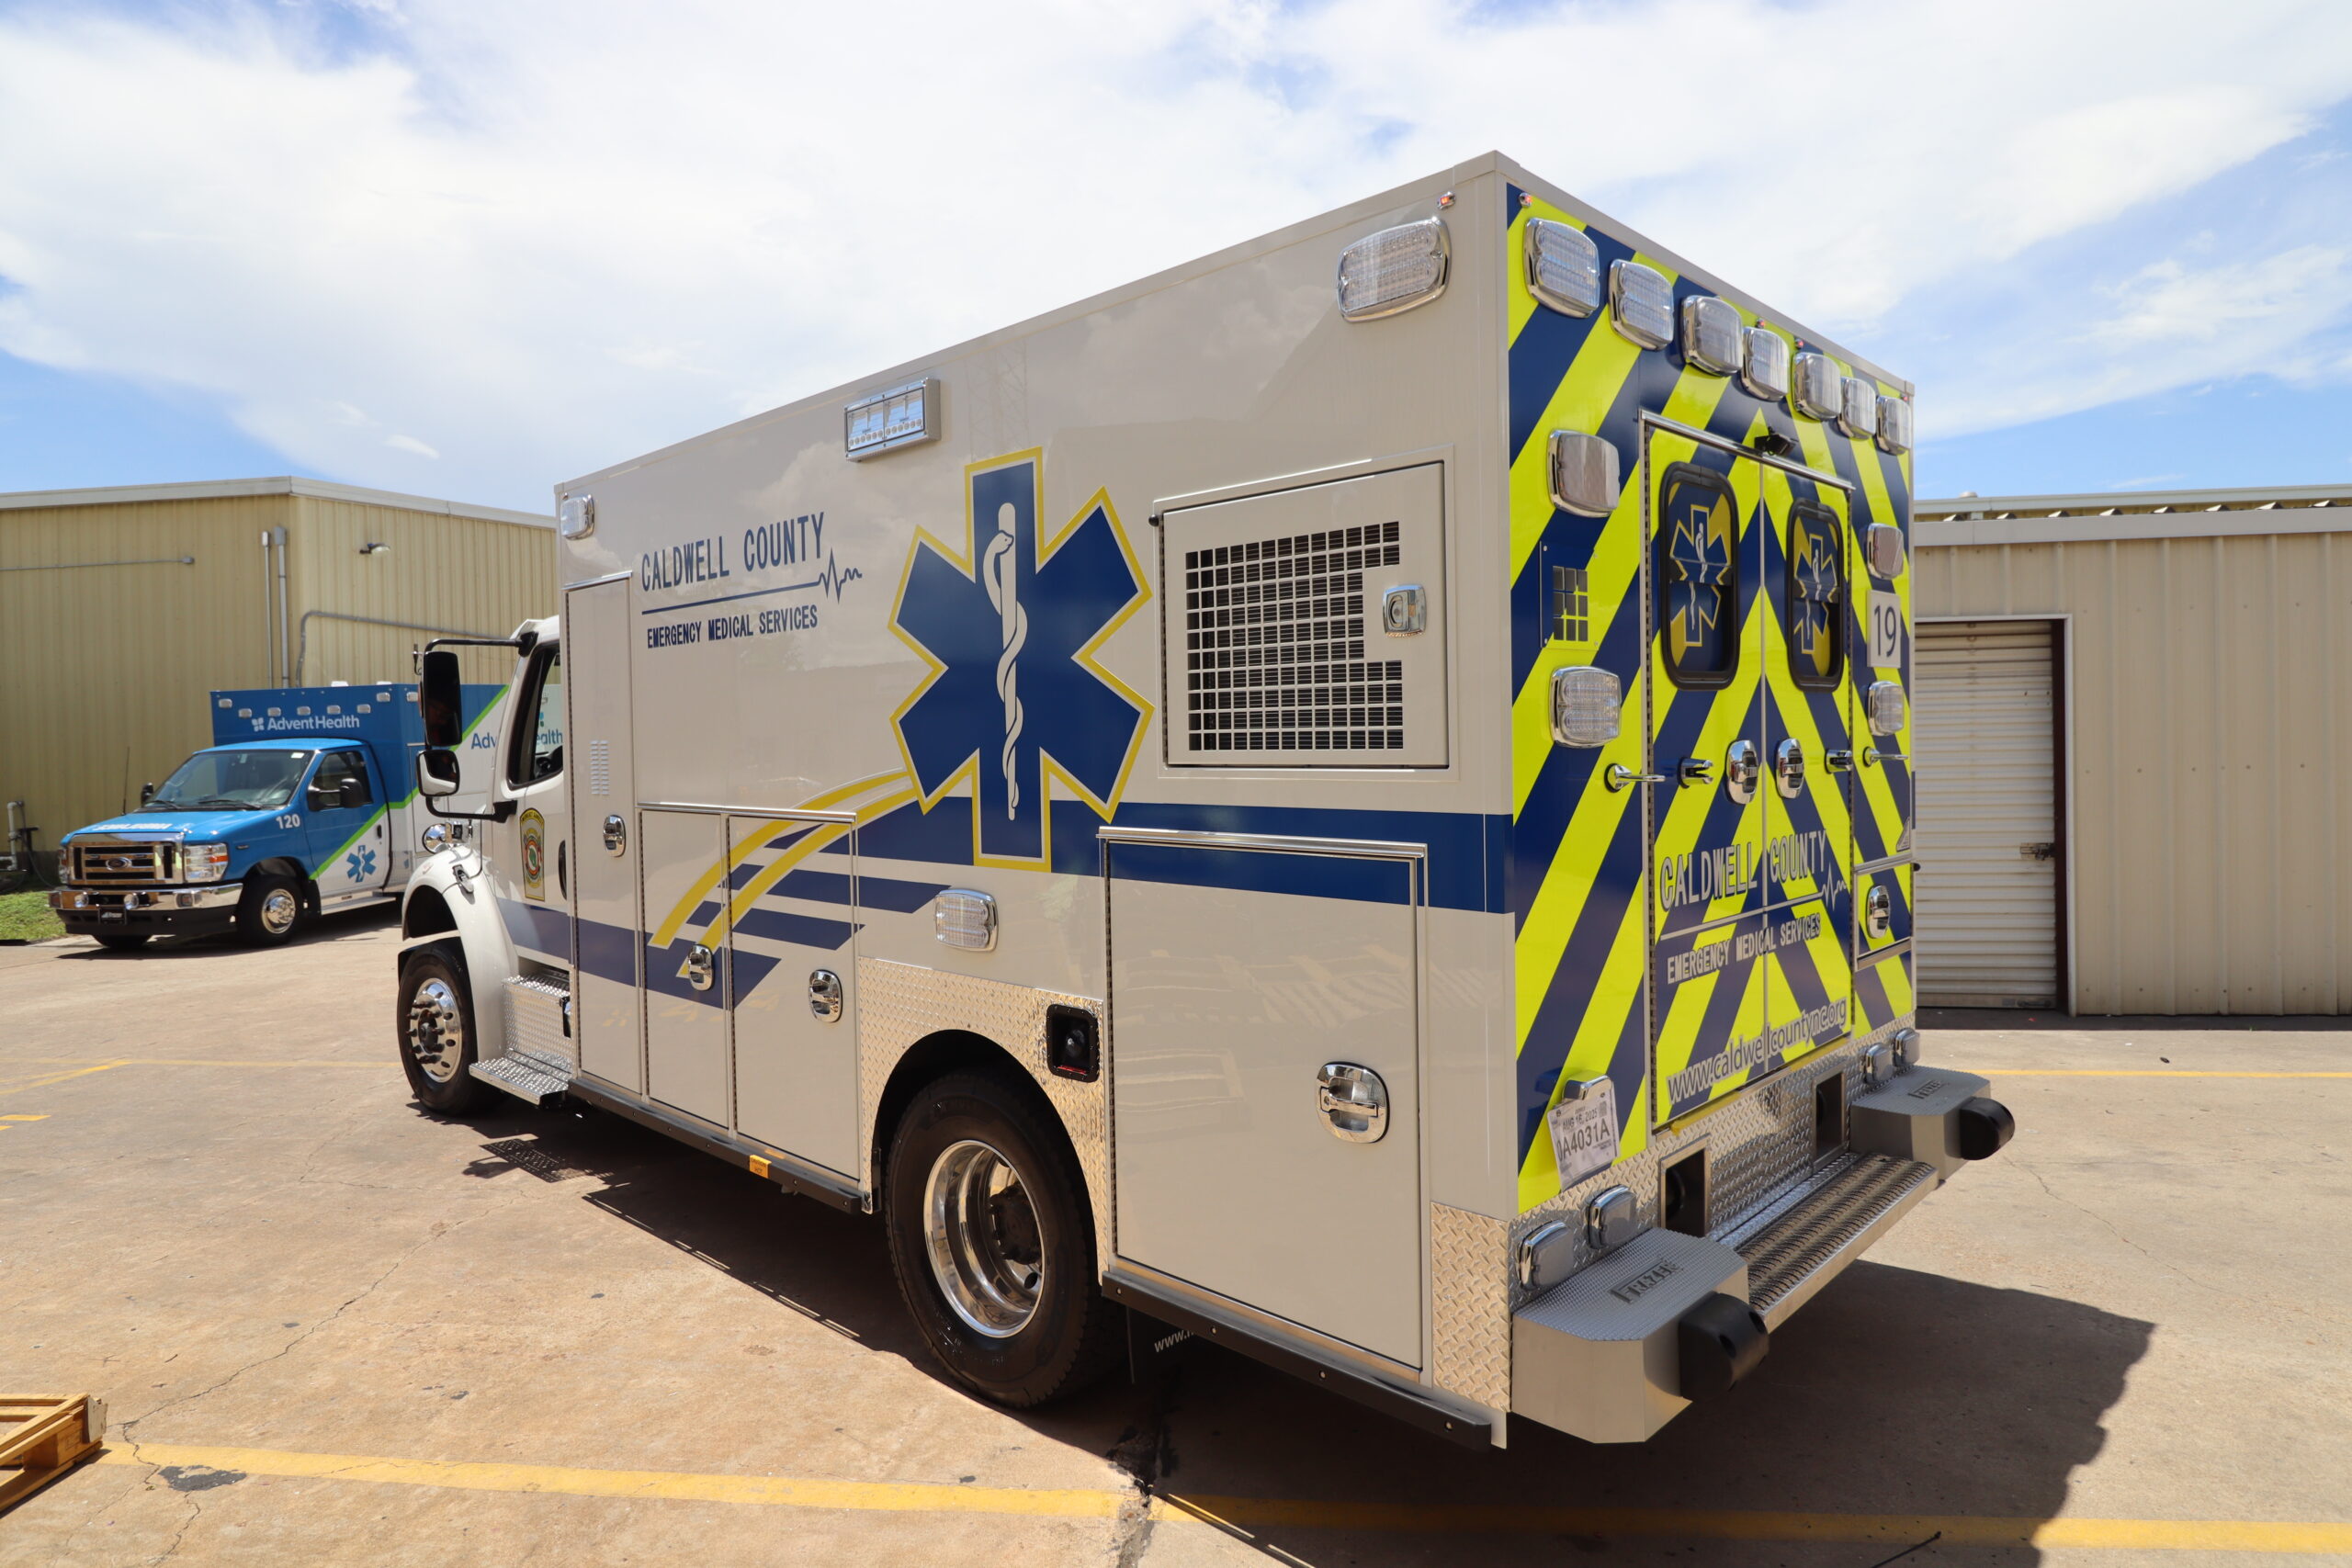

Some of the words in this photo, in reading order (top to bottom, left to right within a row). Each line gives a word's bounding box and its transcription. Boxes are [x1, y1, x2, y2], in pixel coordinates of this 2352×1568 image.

[641, 536, 729, 592] CALDWELL
[743, 512, 824, 572] COUNTY
[647, 621, 702, 649] EMERGENCY
[708, 615, 753, 641] MEDICAL
[759, 604, 818, 635] SERVICES
[1875, 604, 1896, 657] 19
[267, 716, 360, 731] AdventHealth
[276, 813, 301, 829] 120
[1660, 842, 1758, 912] CALDWELL
[1770, 829, 1827, 884] COUNTY
[1668, 939, 1733, 985] EMERGENCY
[1736, 926, 1777, 962] MEDICAL
[1780, 912, 1822, 951] SERVICES
[1667, 998, 1848, 1105] www.caldwelcountync.org
